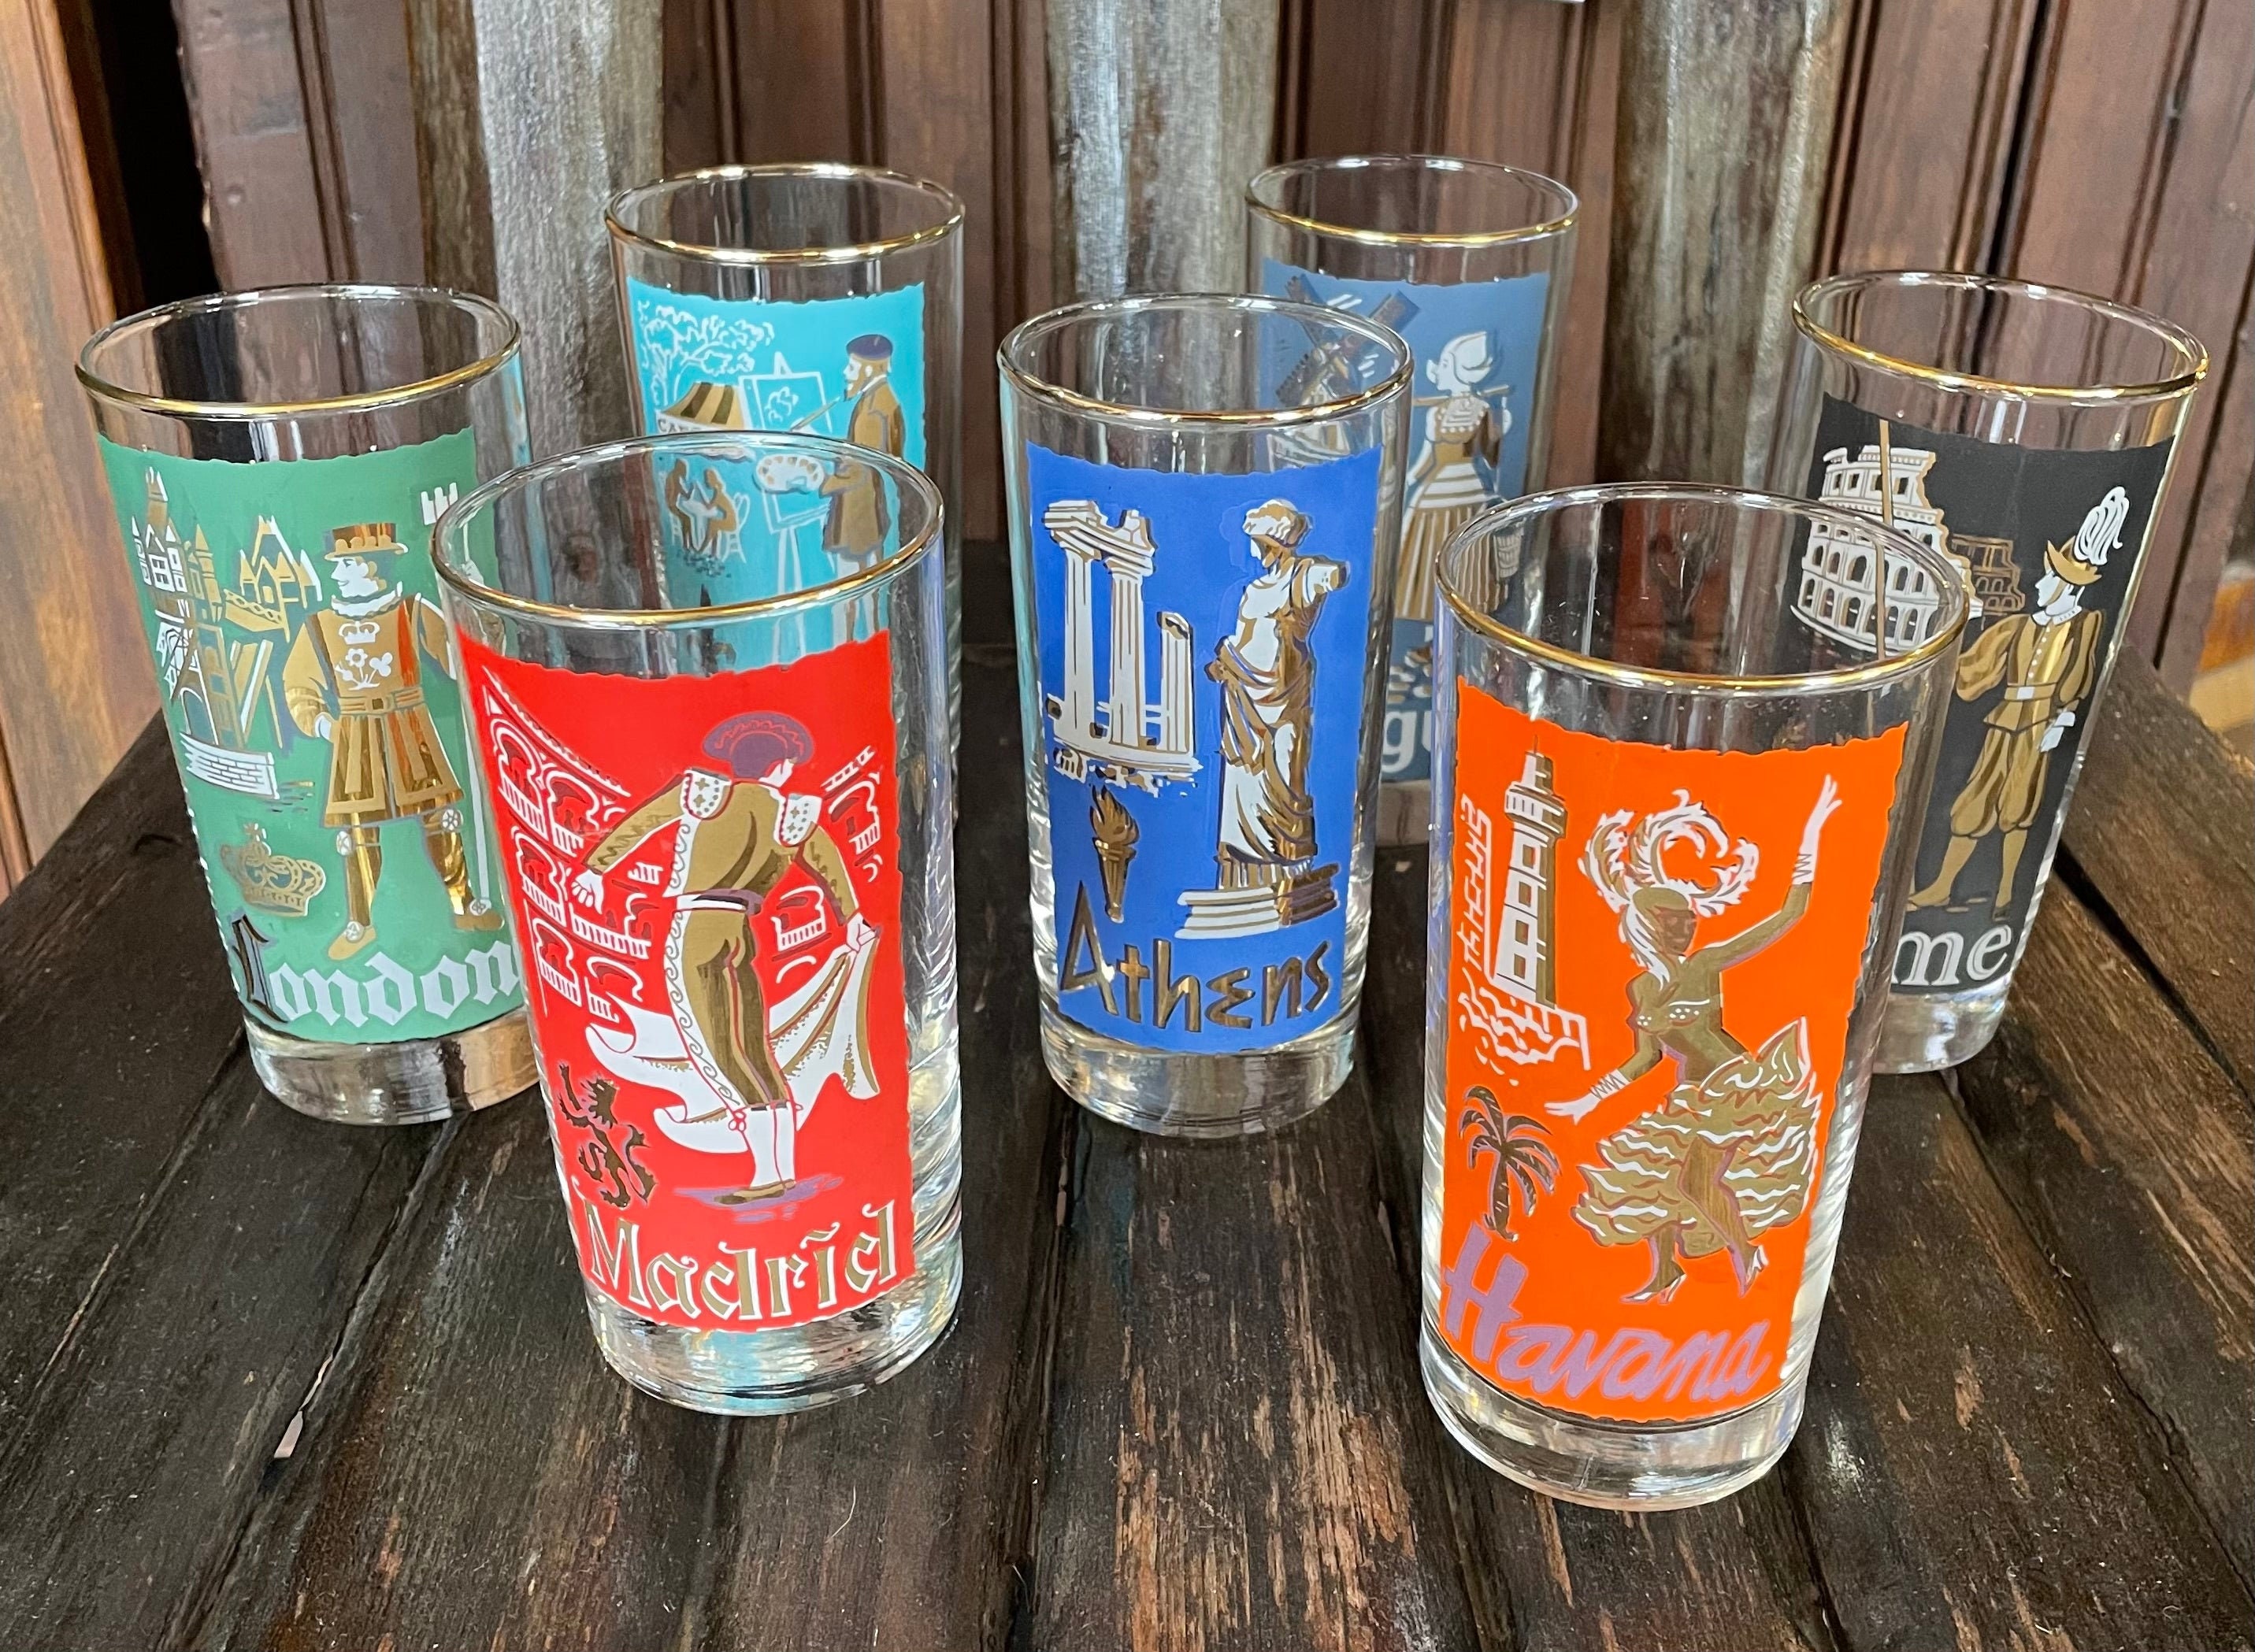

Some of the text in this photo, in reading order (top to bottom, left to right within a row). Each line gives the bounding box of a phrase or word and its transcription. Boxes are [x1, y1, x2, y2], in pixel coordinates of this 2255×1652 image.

[658, 418, 701, 434] CA
[232, 914, 521, 1028] London
[1060, 880, 1331, 1032] Athens
[571, 1175, 899, 1321] Madrid
[1444, 1221, 1772, 1402] Havana
